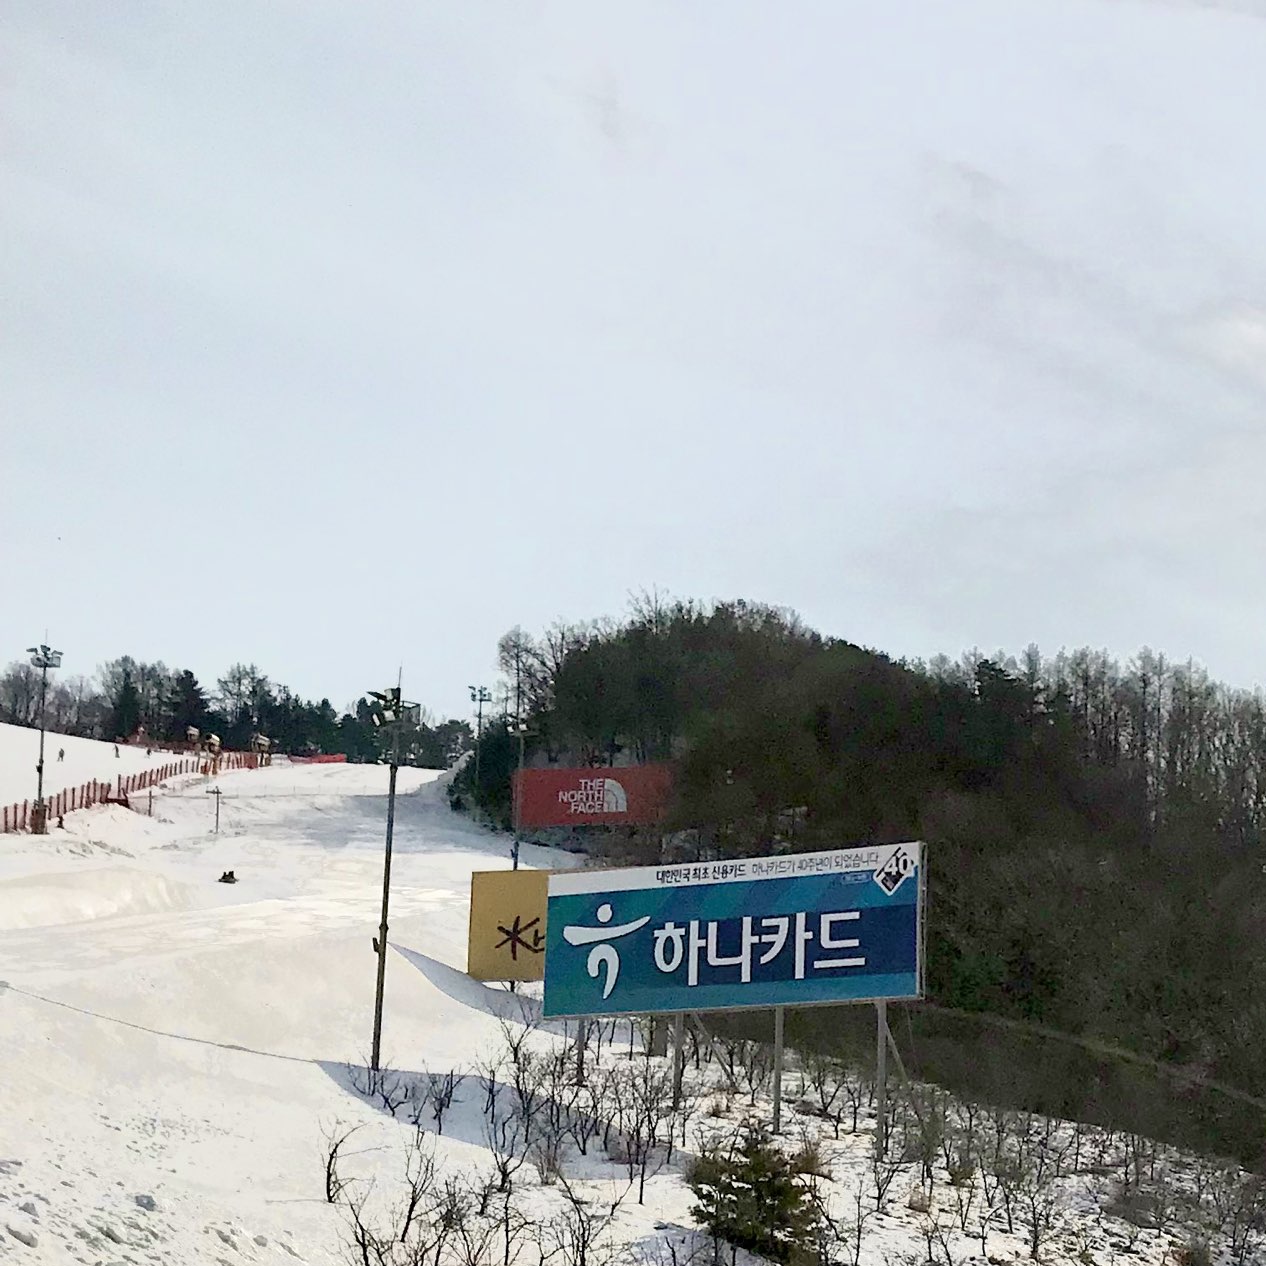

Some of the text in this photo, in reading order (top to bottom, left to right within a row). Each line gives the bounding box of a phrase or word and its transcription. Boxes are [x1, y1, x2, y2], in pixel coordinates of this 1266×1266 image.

[579, 779, 604, 792] THE
[558, 789, 604, 803] NORTH
[570, 801, 604, 814] FACE
[656, 868, 691, 884] 대한민국
[692, 867, 711, 881] 최초
[712, 864, 747, 880] 신용카드
[834, 852, 879, 869] 되었습니다
[653, 911, 866, 986] 하나카드
